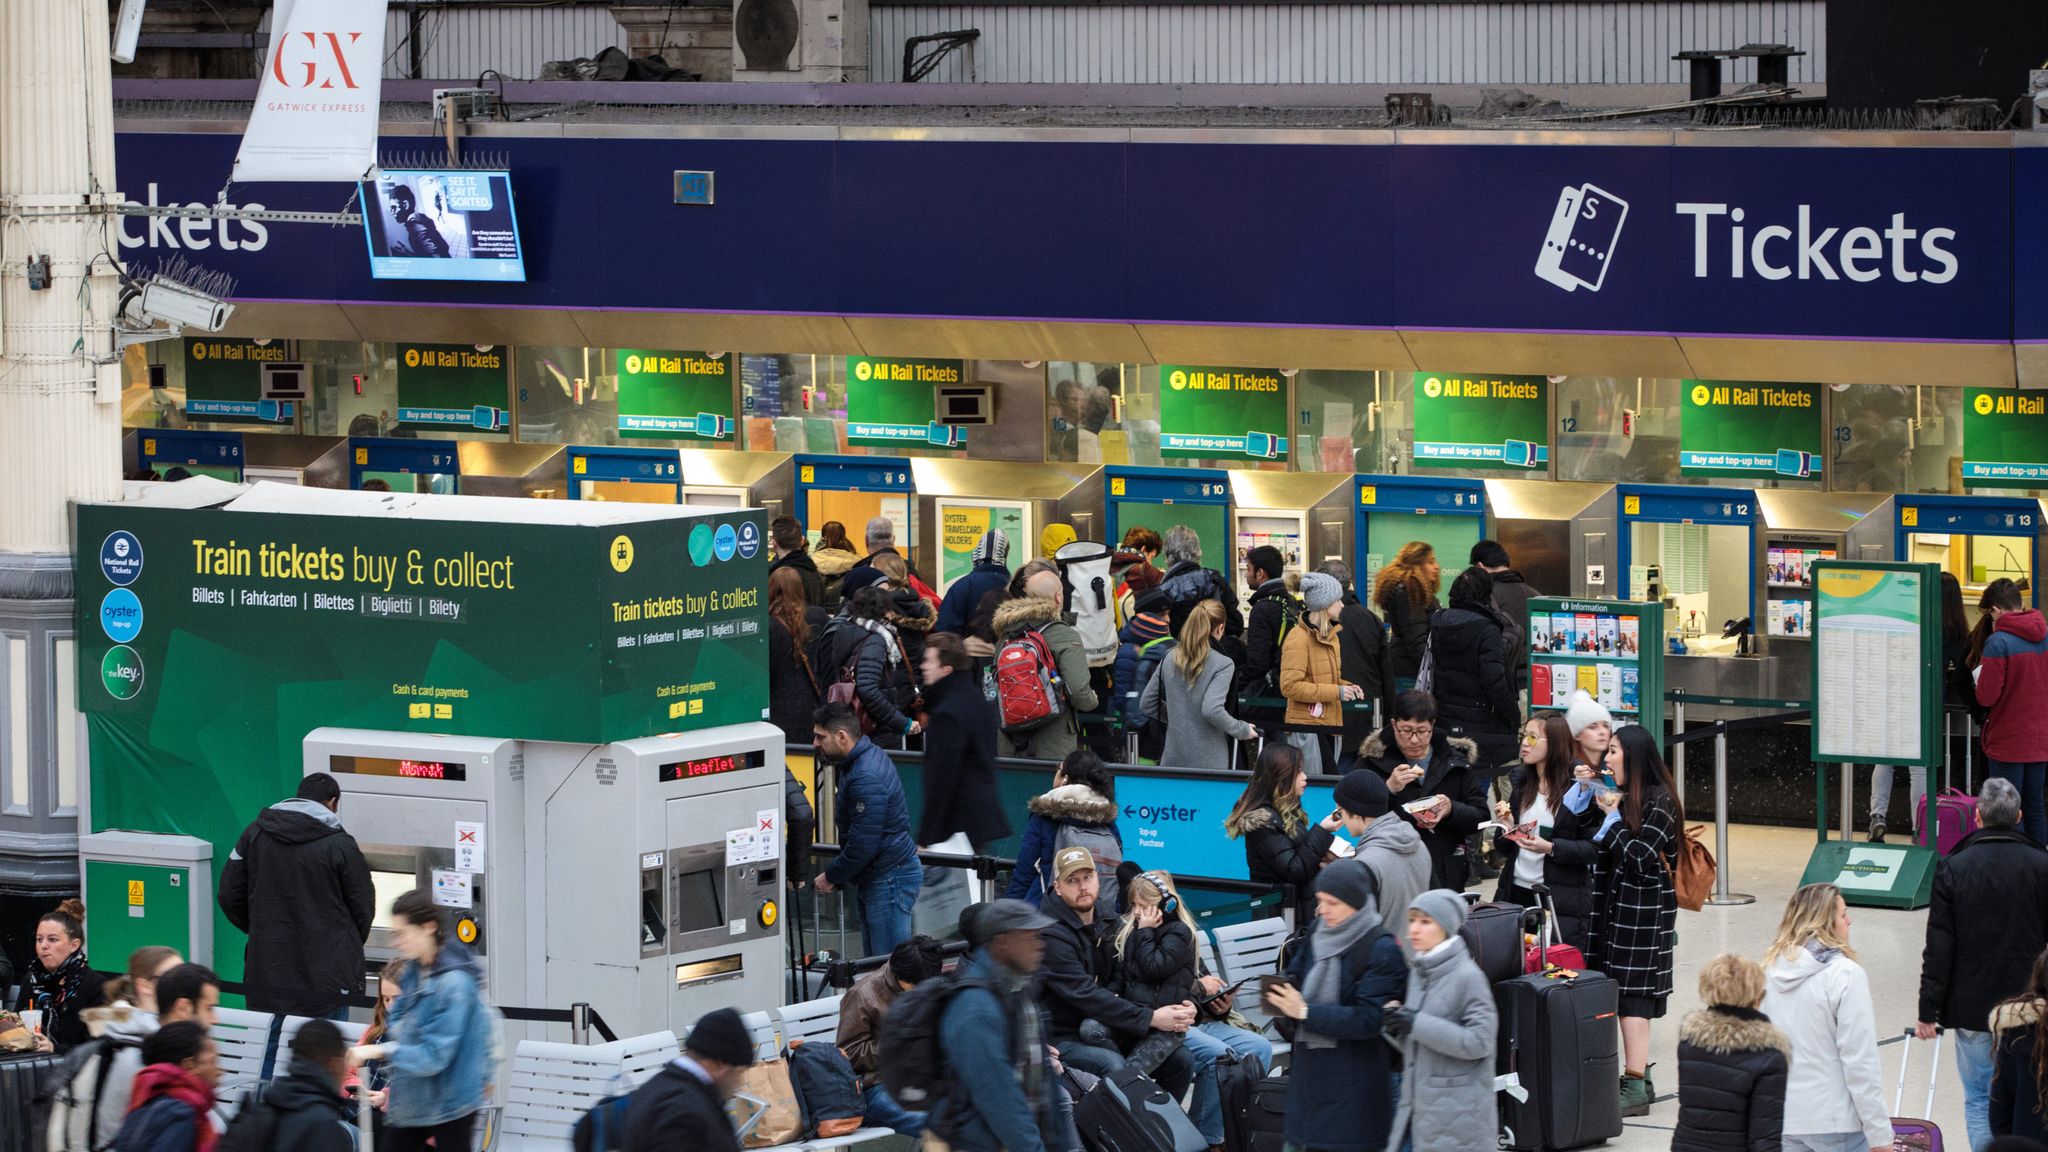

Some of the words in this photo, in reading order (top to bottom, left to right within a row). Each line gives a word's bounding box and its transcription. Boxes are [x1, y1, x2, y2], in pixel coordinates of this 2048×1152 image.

[273, 31, 363, 89] GX
[267, 102, 318, 112] GATWICK
[322, 103, 366, 113] EXPRESS
[448, 176, 465, 187] SEE
[449, 186, 467, 197] SAY
[117, 182, 269, 252] ckets
[1676, 202, 1960, 284] Tickets
[208, 343, 222, 360] All
[224, 344, 243, 360] Rail
[245, 345, 284, 362] Tickets
[422, 351, 435, 366] All
[438, 351, 458, 367] Rail
[460, 352, 500, 369] Tickets
[643, 356, 657, 373] All
[660, 357, 681, 374] Rail
[683, 358, 724, 375] Tickets
[873, 363, 888, 380] All
[891, 364, 913, 381] Rail
[915, 365, 958, 382] Tickets
[1189, 372, 1204, 389] All
[1207, 373, 1230, 391] Rail
[1233, 374, 1278, 392] Tickets
[1444, 379, 1460, 397] All
[1463, 380, 1488, 398] Rail
[1490, 380, 1538, 399] Tickets
[745, 396, 755, 410] 9
[1712, 387, 1729, 405] All
[1733, 388, 1758, 406] Rail
[1761, 389, 1811, 408] Tickets
[194, 402, 206, 412] Buy
[207, 403, 219, 411] and
[220, 403, 241, 414] top-up
[242, 404, 257, 412] here
[1996, 396, 2014, 414] All
[2018, 397, 2044, 415] Rail
[406, 410, 419, 420] Buy
[420, 411, 432, 419] and
[433, 412, 455, 422] top-up
[456, 412, 471, 421] here
[1301, 410, 1311, 425] 11
[627, 418, 641, 428] Buy
[641, 418, 654, 427] and
[655, 418, 678, 429] top-up
[678, 419, 694, 429] here
[1561, 418, 1577, 433] 12
[856, 426, 869, 436] Buy
[870, 426, 884, 435] and
[885, 427, 909, 437] top-up
[909, 428, 926, 436] here
[1834, 426, 1852, 442] 13
[1170, 437, 1184, 447] Buy
[1185, 437, 1199, 446] and
[1200, 438, 1225, 449] top-up
[1226, 439, 1243, 448] here
[232, 446, 239, 456] 6
[1423, 445, 1439, 456] Buy
[1440, 446, 1455, 455] and
[1456, 446, 1482, 458] top-up
[1483, 447, 1501, 457] here
[445, 455, 452, 465] 7
[1691, 455, 1707, 465] Buy
[1708, 455, 1724, 464] and
[1725, 456, 1753, 467] top-up
[1754, 457, 1773, 466] here
[667, 464, 675, 475] 8
[1974, 465, 1990, 476] Buy
[1991, 465, 2008, 475] and
[2009, 466, 2038, 477] top-up
[898, 473, 906, 484] 9
[1213, 484, 1224, 495] 10
[1469, 494, 1477, 505] 11
[1736, 504, 1748, 516] 12
[944, 515, 967, 523] OYSTER
[2019, 514, 2031, 526] 13
[944, 525, 982, 534] TRAVELCARD
[944, 536, 973, 545] HOLDERS
[104, 557, 127, 566] National
[128, 558, 139, 567] Rail
[192, 539, 251, 577] Train
[259, 542, 345, 582] tickets
[353, 546, 398, 592] buy
[406, 549, 424, 585] &
[433, 551, 515, 590] collect
[112, 566, 132, 575] Tickets
[192, 587, 225, 605] Billets
[240, 589, 297, 608] Fahrkarten
[313, 593, 354, 611] Bilettes
[371, 596, 412, 616] Biglietti
[429, 599, 460, 620] Bilety
[612, 600, 641, 623] Train
[644, 596, 683, 620] tickets
[686, 593, 707, 617] buy
[710, 590, 719, 611] &
[722, 587, 758, 610] collect
[1570, 602, 1608, 613] Information
[104, 605, 138, 619] oyster
[617, 636, 636, 648] Billets
[643, 631, 674, 645] Fahrkarten
[682, 627, 704, 641] Bilettes
[712, 623, 734, 638] Biglietti
[742, 620, 758, 634] Bilety
[393, 683, 410, 695] Cash
[411, 685, 417, 695] &
[418, 685, 434, 696] card
[435, 686, 469, 699] payments
[656, 685, 671, 697] Cash
[671, 684, 676, 695] &
[677, 683, 689, 694] card
[689, 681, 716, 694] payments
[1139, 803, 1197, 824] oyster
[1139, 827, 1158, 837] Top-up
[1139, 839, 1165, 848] Purchase
